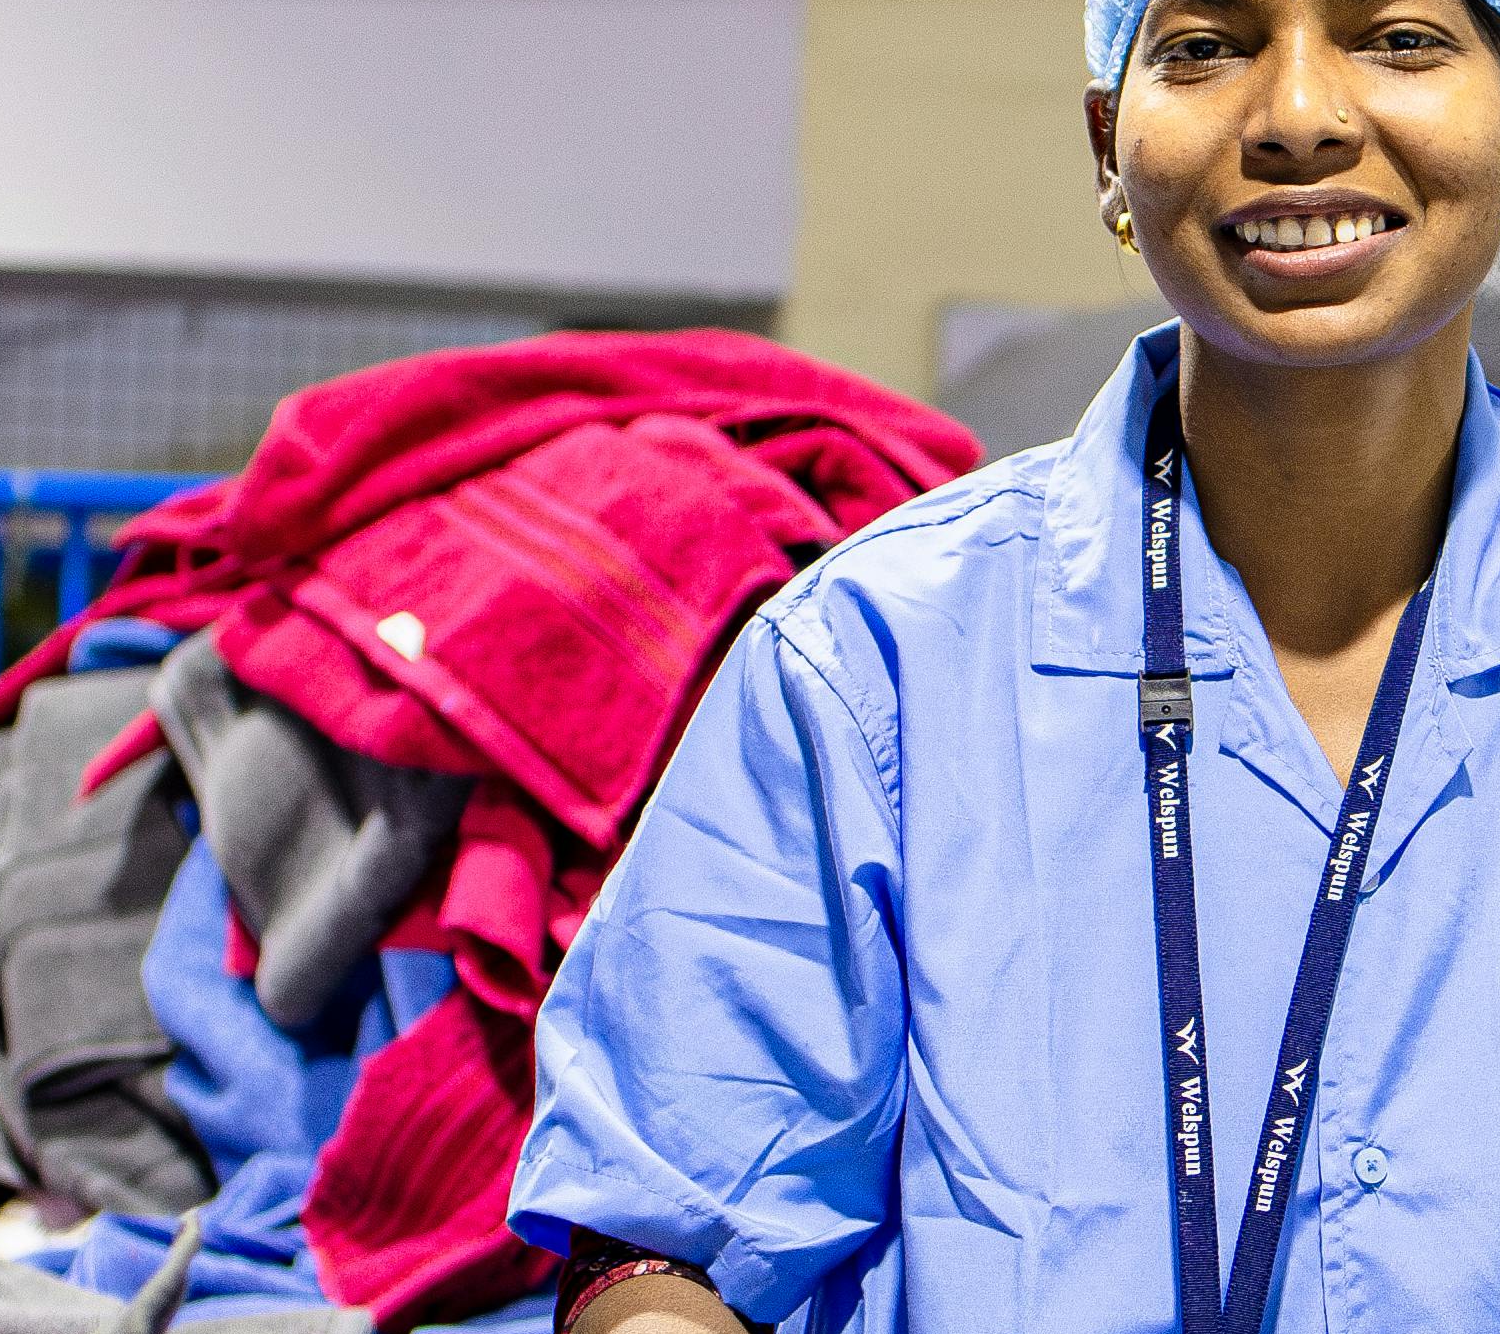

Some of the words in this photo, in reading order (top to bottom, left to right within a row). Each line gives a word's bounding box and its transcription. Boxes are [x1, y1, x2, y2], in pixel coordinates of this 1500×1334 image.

[1147, 498, 1172, 589] Welspun
[1155, 762, 1181, 859] Welspun
[1327, 811, 1371, 901] Welspun
[1178, 1076, 1203, 1177] Welspun
[1255, 1116, 1297, 1213] Welspun
